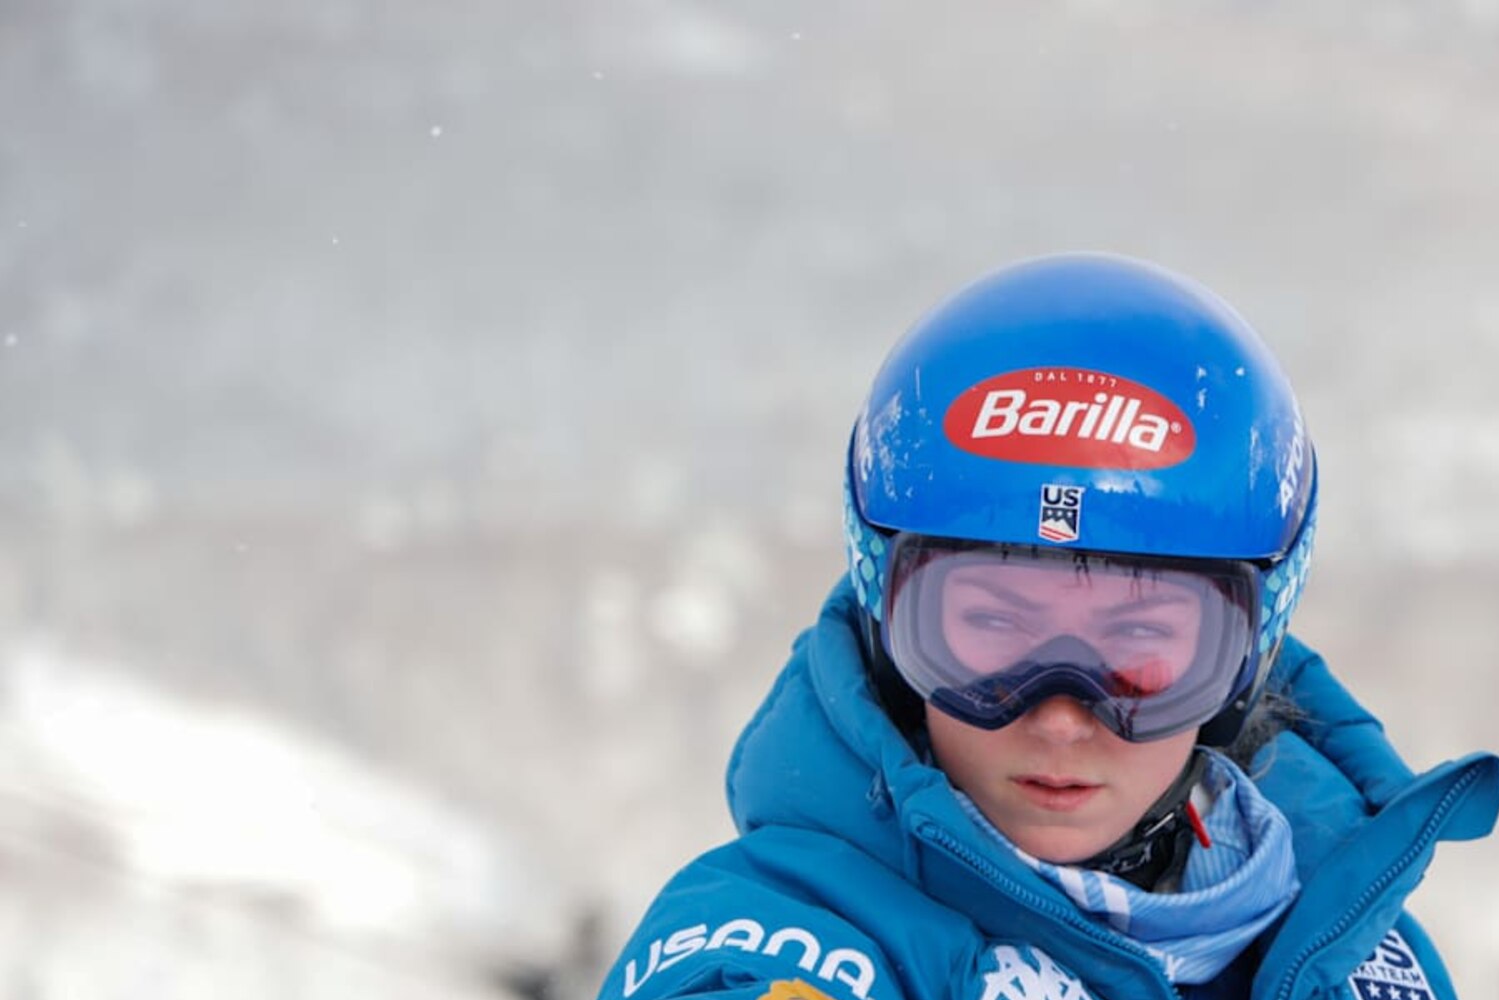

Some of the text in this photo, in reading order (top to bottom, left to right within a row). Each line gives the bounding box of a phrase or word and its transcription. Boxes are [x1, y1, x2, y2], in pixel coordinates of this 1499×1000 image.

[1034, 371, 1118, 388] DAL 1877
[971, 389, 1170, 452] Barilla
[1043, 487, 1080, 507] US
